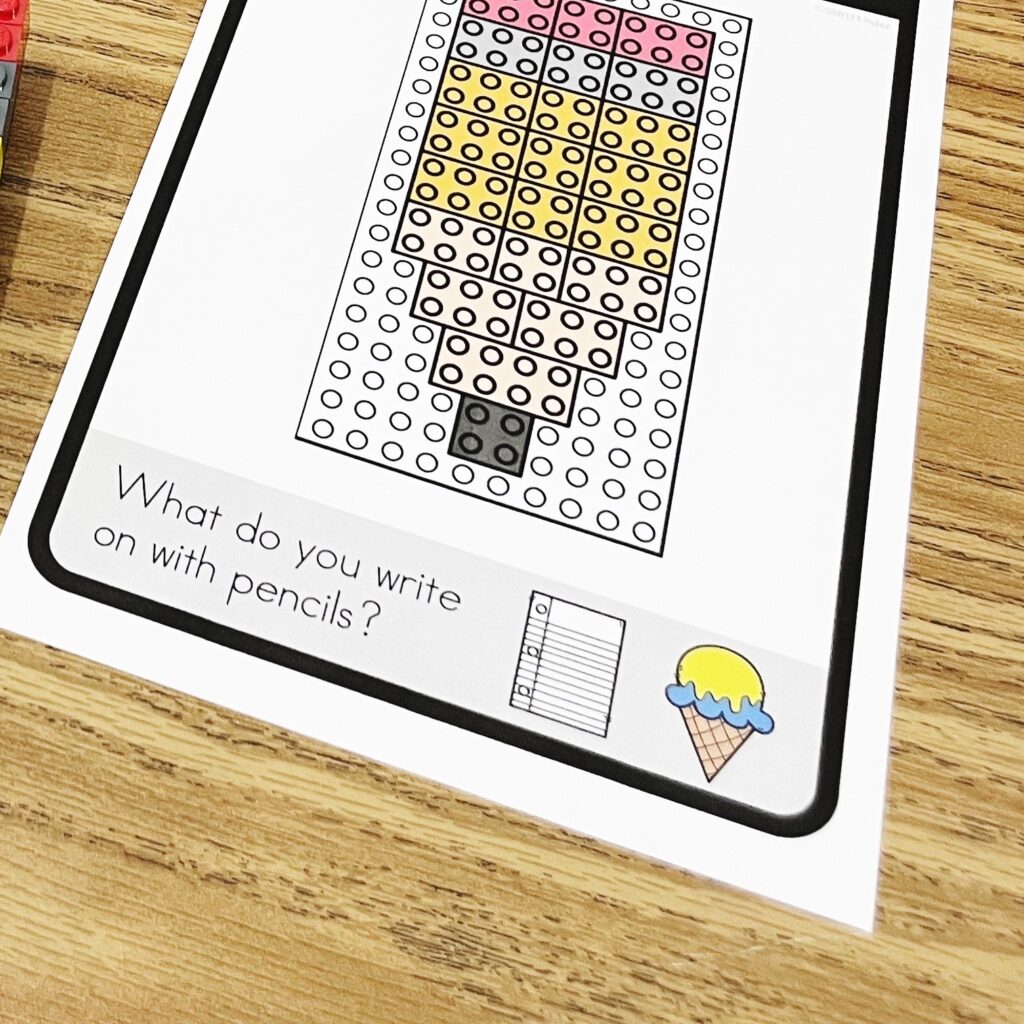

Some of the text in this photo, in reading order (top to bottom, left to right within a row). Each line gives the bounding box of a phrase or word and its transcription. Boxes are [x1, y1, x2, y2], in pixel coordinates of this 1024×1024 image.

[94, 526, 381, 636] on with pencils?
[118, 464, 461, 611] What do you write
